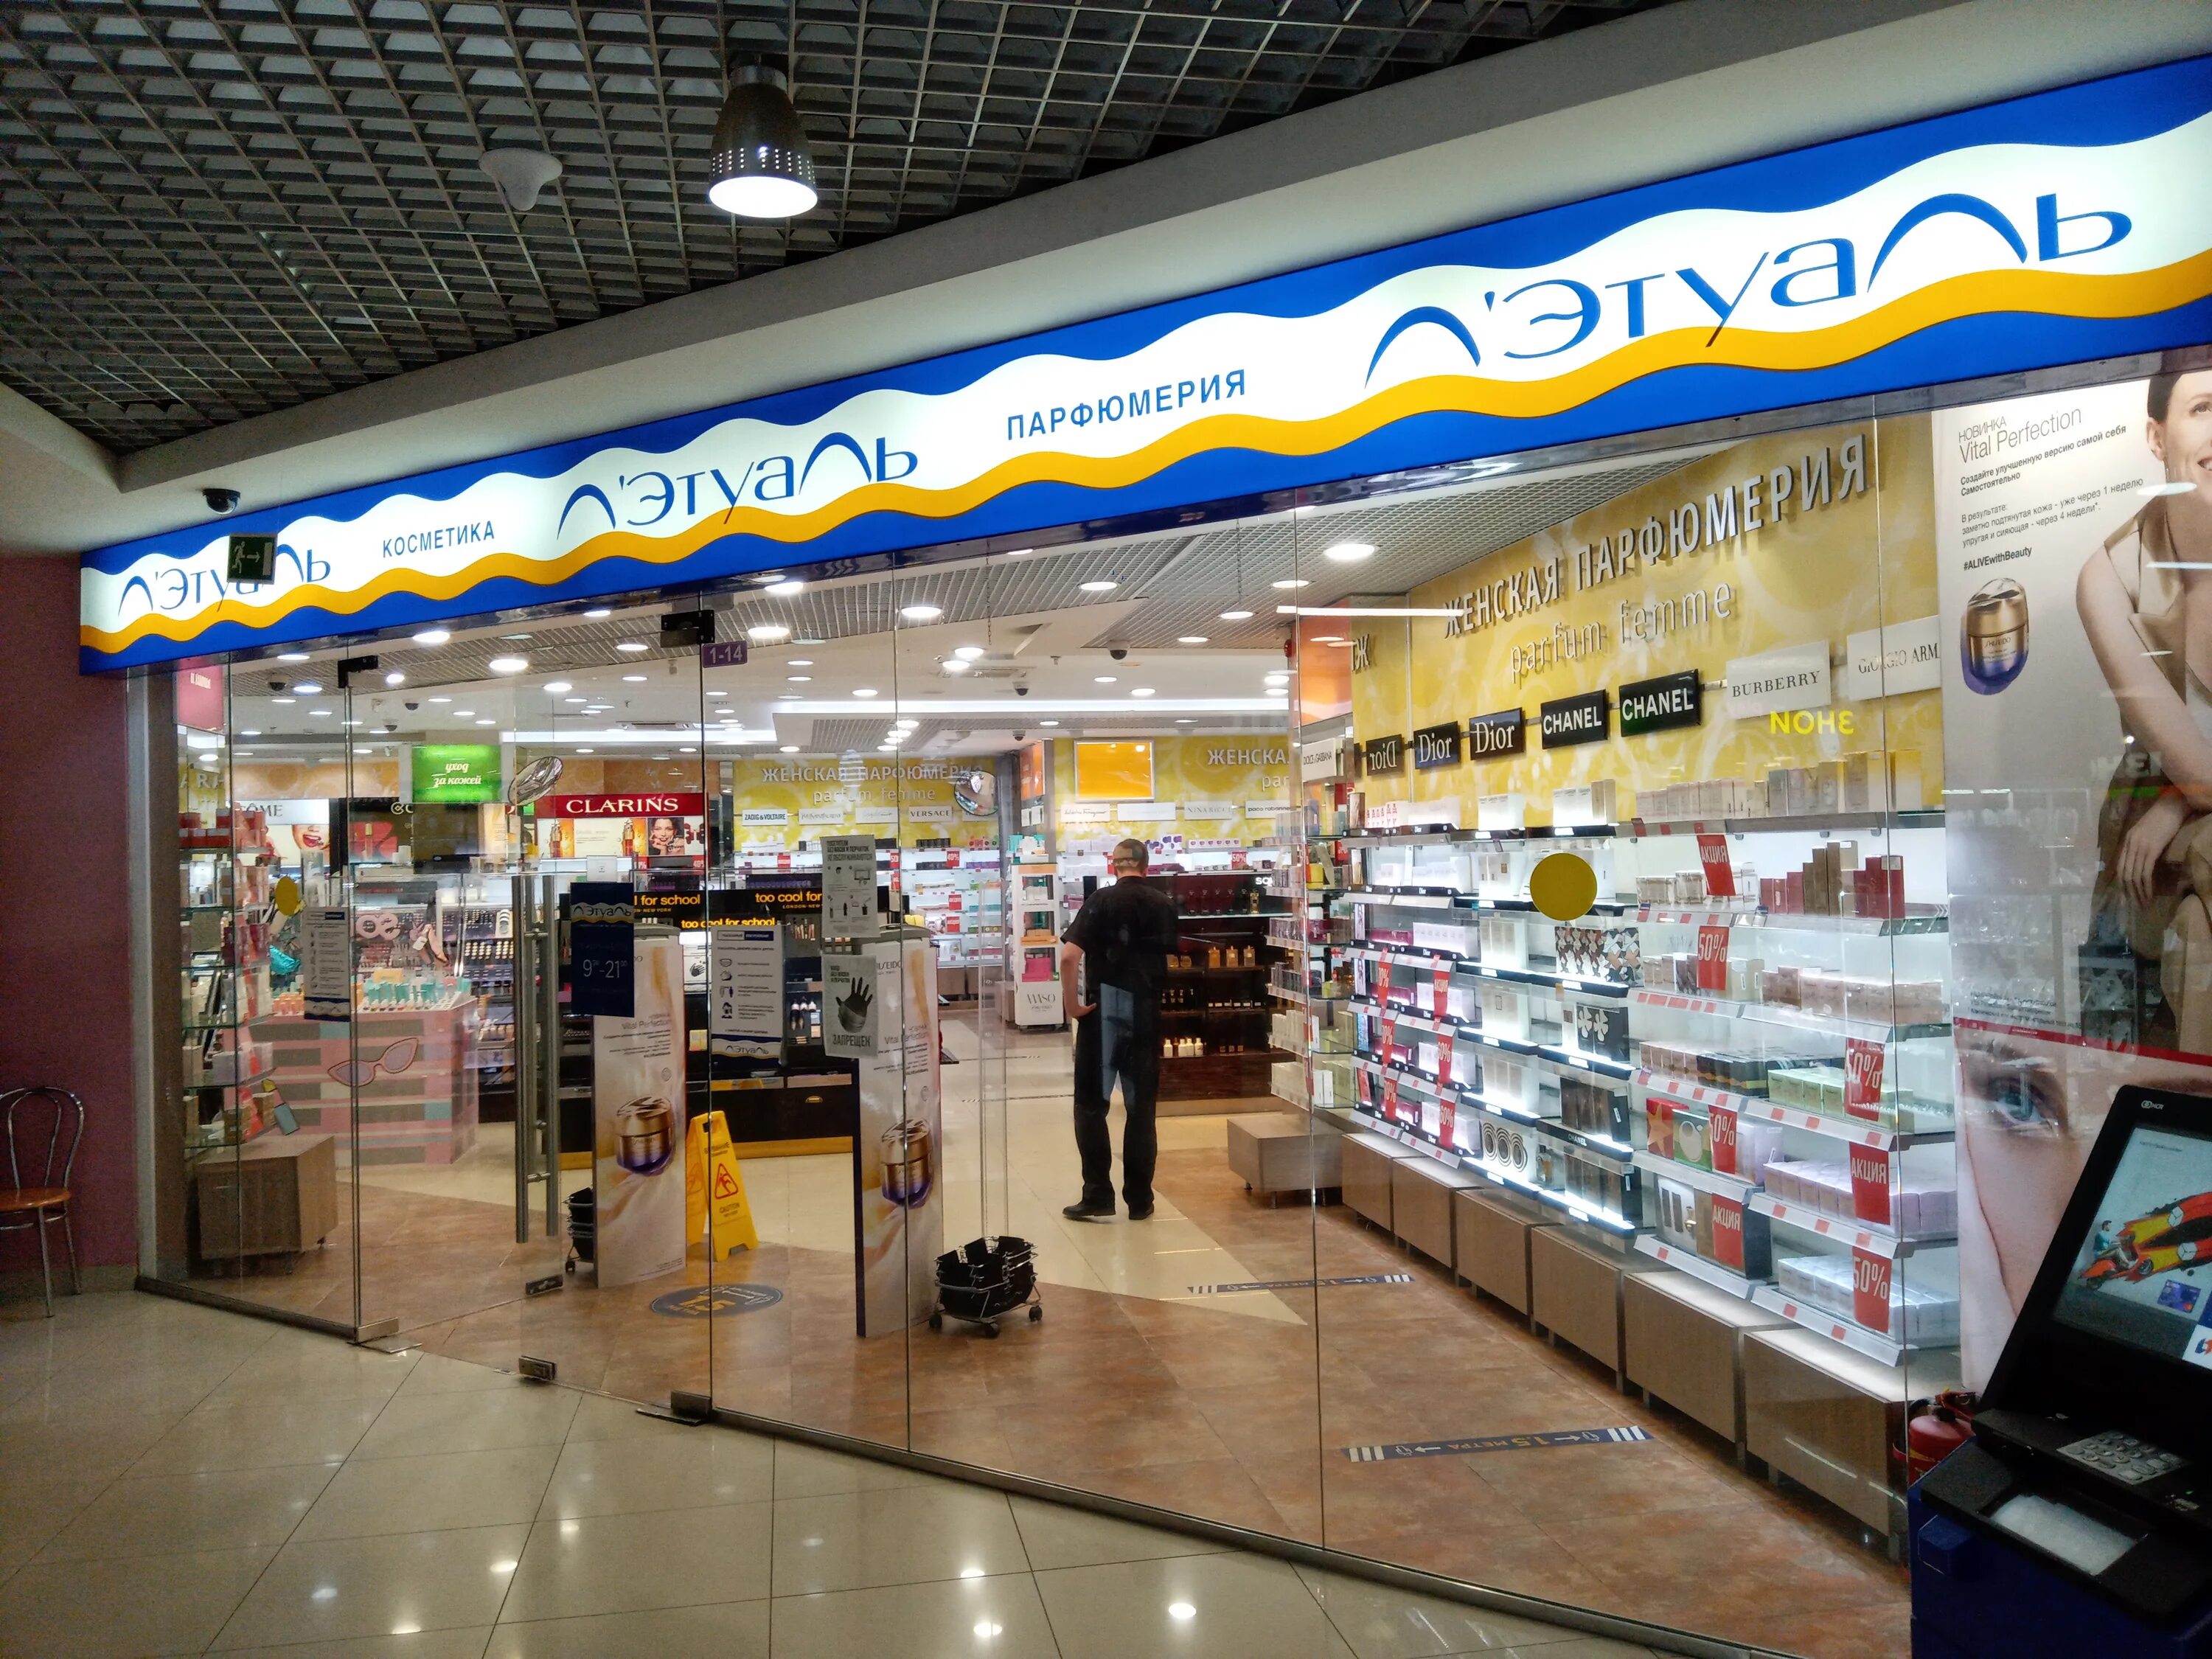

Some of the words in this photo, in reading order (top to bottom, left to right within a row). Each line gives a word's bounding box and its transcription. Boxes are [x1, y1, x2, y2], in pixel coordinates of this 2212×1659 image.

[1364, 193, 2133, 389] Л'Этуаль
[1006, 369, 1247, 441] ПАРФЮМЕРИЯ
[1958, 415, 2007, 443] НОВИНКА
[1959, 435, 1992, 464] Vital
[1997, 408, 2082, 452] Perfection
[1960, 467, 1994, 486] Создайте
[1995, 453, 2042, 477] улучшенную
[2044, 440, 2075, 459] версию
[2076, 431, 2104, 448] самой
[2105, 424, 2127, 439] себя
[557, 431, 919, 541] Л'Этуаль
[1961, 471, 2021, 497] Самостоятельно
[1961, 514, 1967, 524] В
[1962, 521, 1990, 536] заметно
[1991, 508, 2032, 530] подтянутая
[2033, 503, 2053, 516] кожа
[2059, 496, 2076, 509] уже
[2076, 490, 2101, 505] через
[2110, 477, 2144, 494] неделю
[382, 520, 495, 559] КОСМЕТИКА
[1443, 557, 1561, 640] ЖЕНСКАЯ
[1576, 433, 1871, 591] ПАРФЮМЕРИЯ
[1962, 532, 1989, 549] упругая
[1995, 522, 2030, 538] сияющая
[2035, 515, 2059, 528] через
[1963, 546, 2033, 571] #ALIVEwithBeauty
[1512, 618, 1603, 686] parfum
[1621, 581, 1733, 644] femme
[709, 645, 743, 664] 1-14
[1732, 669, 1822, 698] BURBERRY
[1621, 686, 1694, 722] CHANEL
[1543, 706, 1603, 736] CHANEL
[1418, 734, 1453, 765] Dior
[1475, 718, 1515, 755] Dior
[1207, 748, 1290, 765] ЖЕНСКА
[566, 797, 679, 815] CLARINS
[764, 813, 786, 821] VOLTAIRE
[910, 810, 950, 818] VERSACE
[1231, 852, 1247, 864] 50%
[1700, 844, 1730, 864] АКЦИЯ
[641, 894, 658, 905] for
[660, 894, 701, 905] school
[754, 892, 776, 903] too
[777, 890, 804, 902] cool
[805, 890, 823, 902] for
[681, 919, 699, 929] too
[725, 918, 740, 926] for
[740, 917, 776, 926] school
[1697, 933, 1728, 962] 50%
[1851, 1155, 1888, 1185] АКЦИЯ
[1712, 1203, 1742, 1232] АКЦИЯ
[1851, 1255, 1890, 1301] 50%
